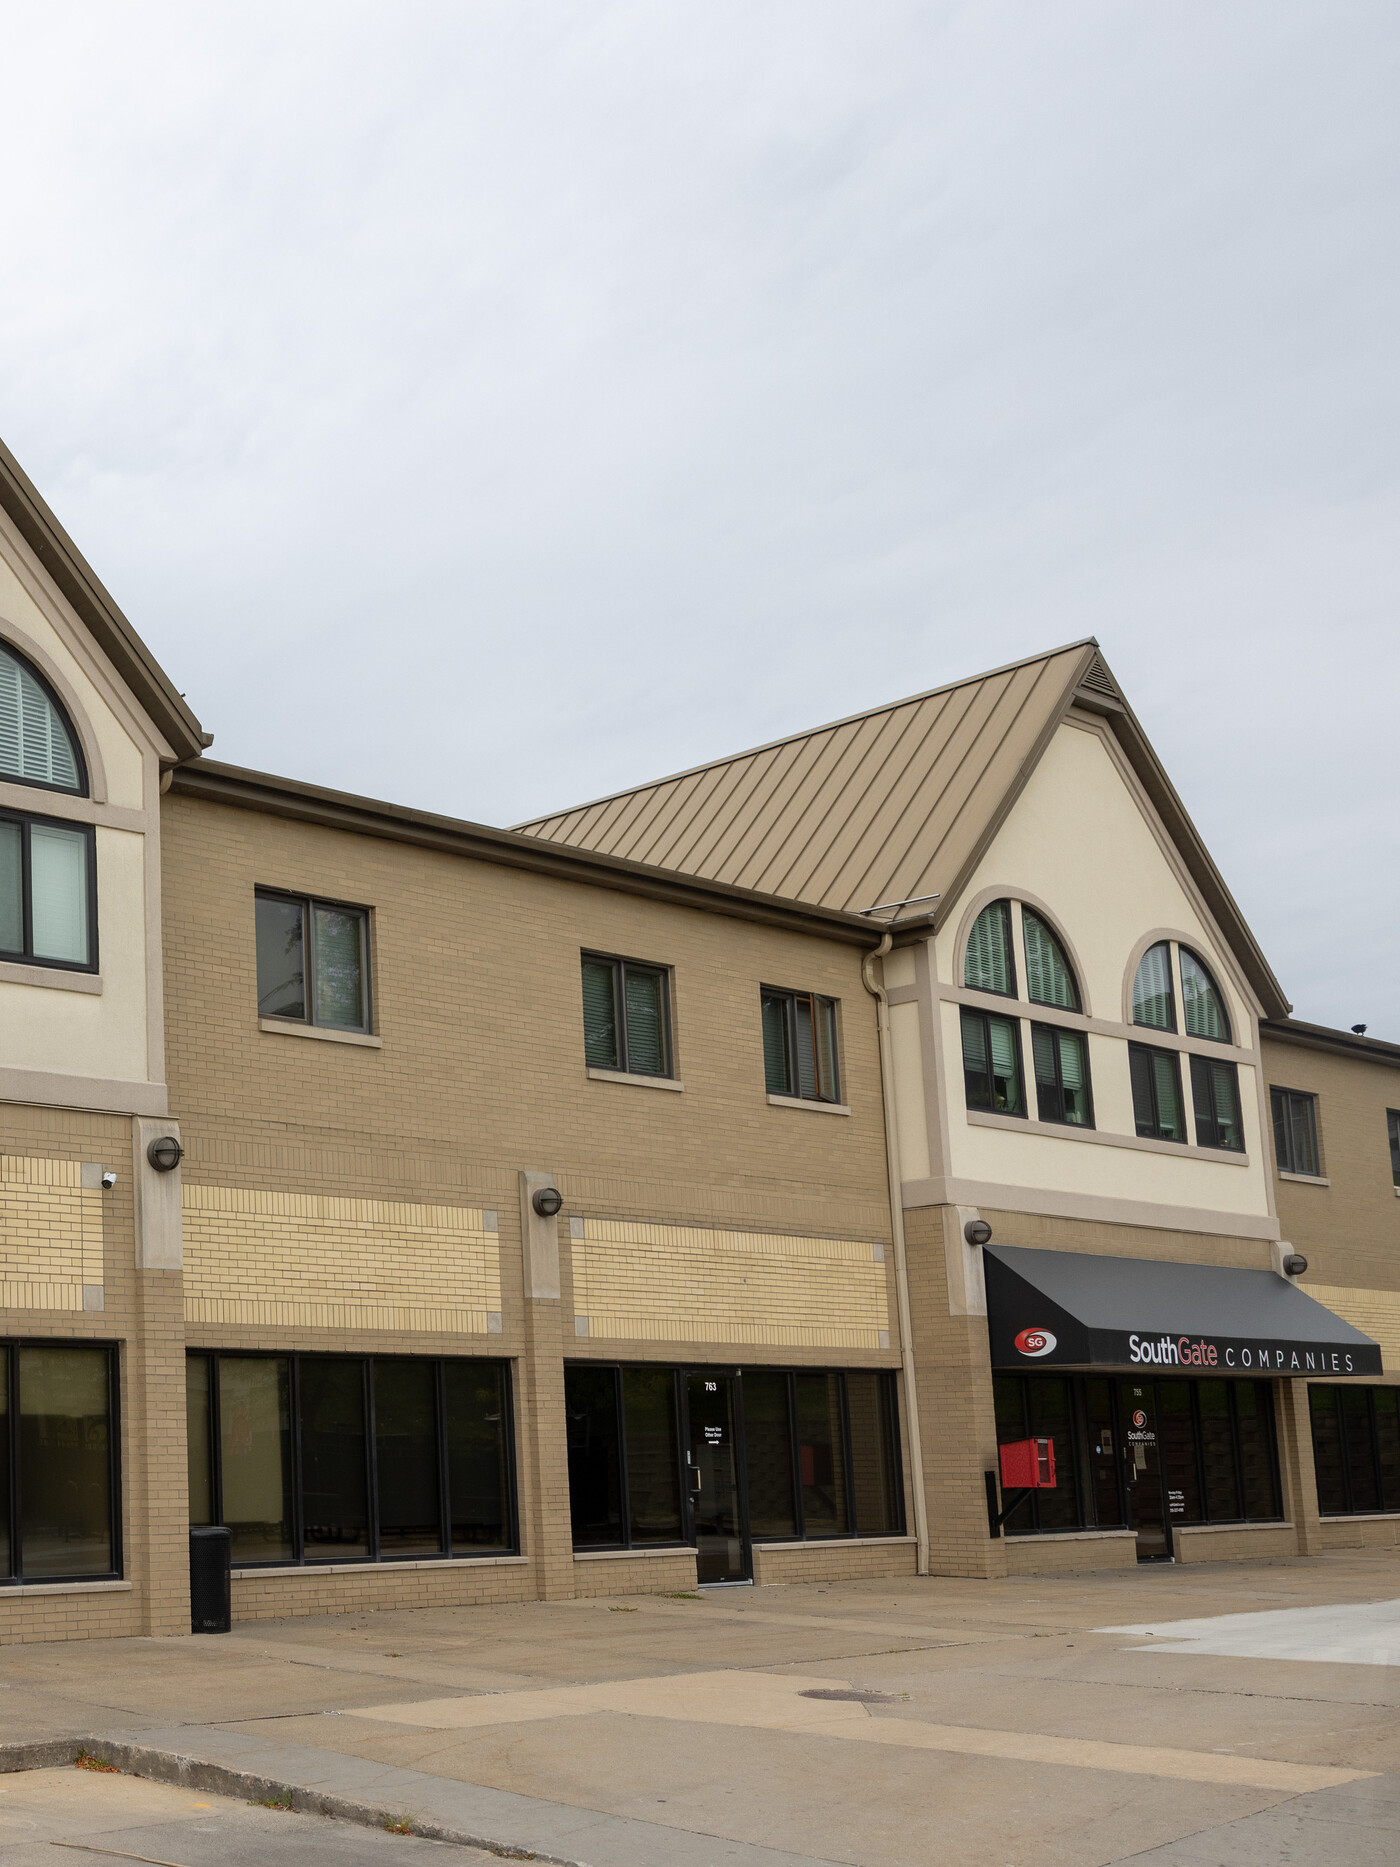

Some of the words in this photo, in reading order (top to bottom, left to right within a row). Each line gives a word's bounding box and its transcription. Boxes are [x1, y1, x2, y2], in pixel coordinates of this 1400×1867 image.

[1027, 1337, 1044, 1347] SG
[1129, 1334, 1218, 1366] SouthGate
[1225, 1348, 1354, 1372] COMPANIES
[705, 1382, 717, 1391] 763
[1133, 1388, 1142, 1396] 755
[1127, 1431, 1155, 1440] SouthGate
